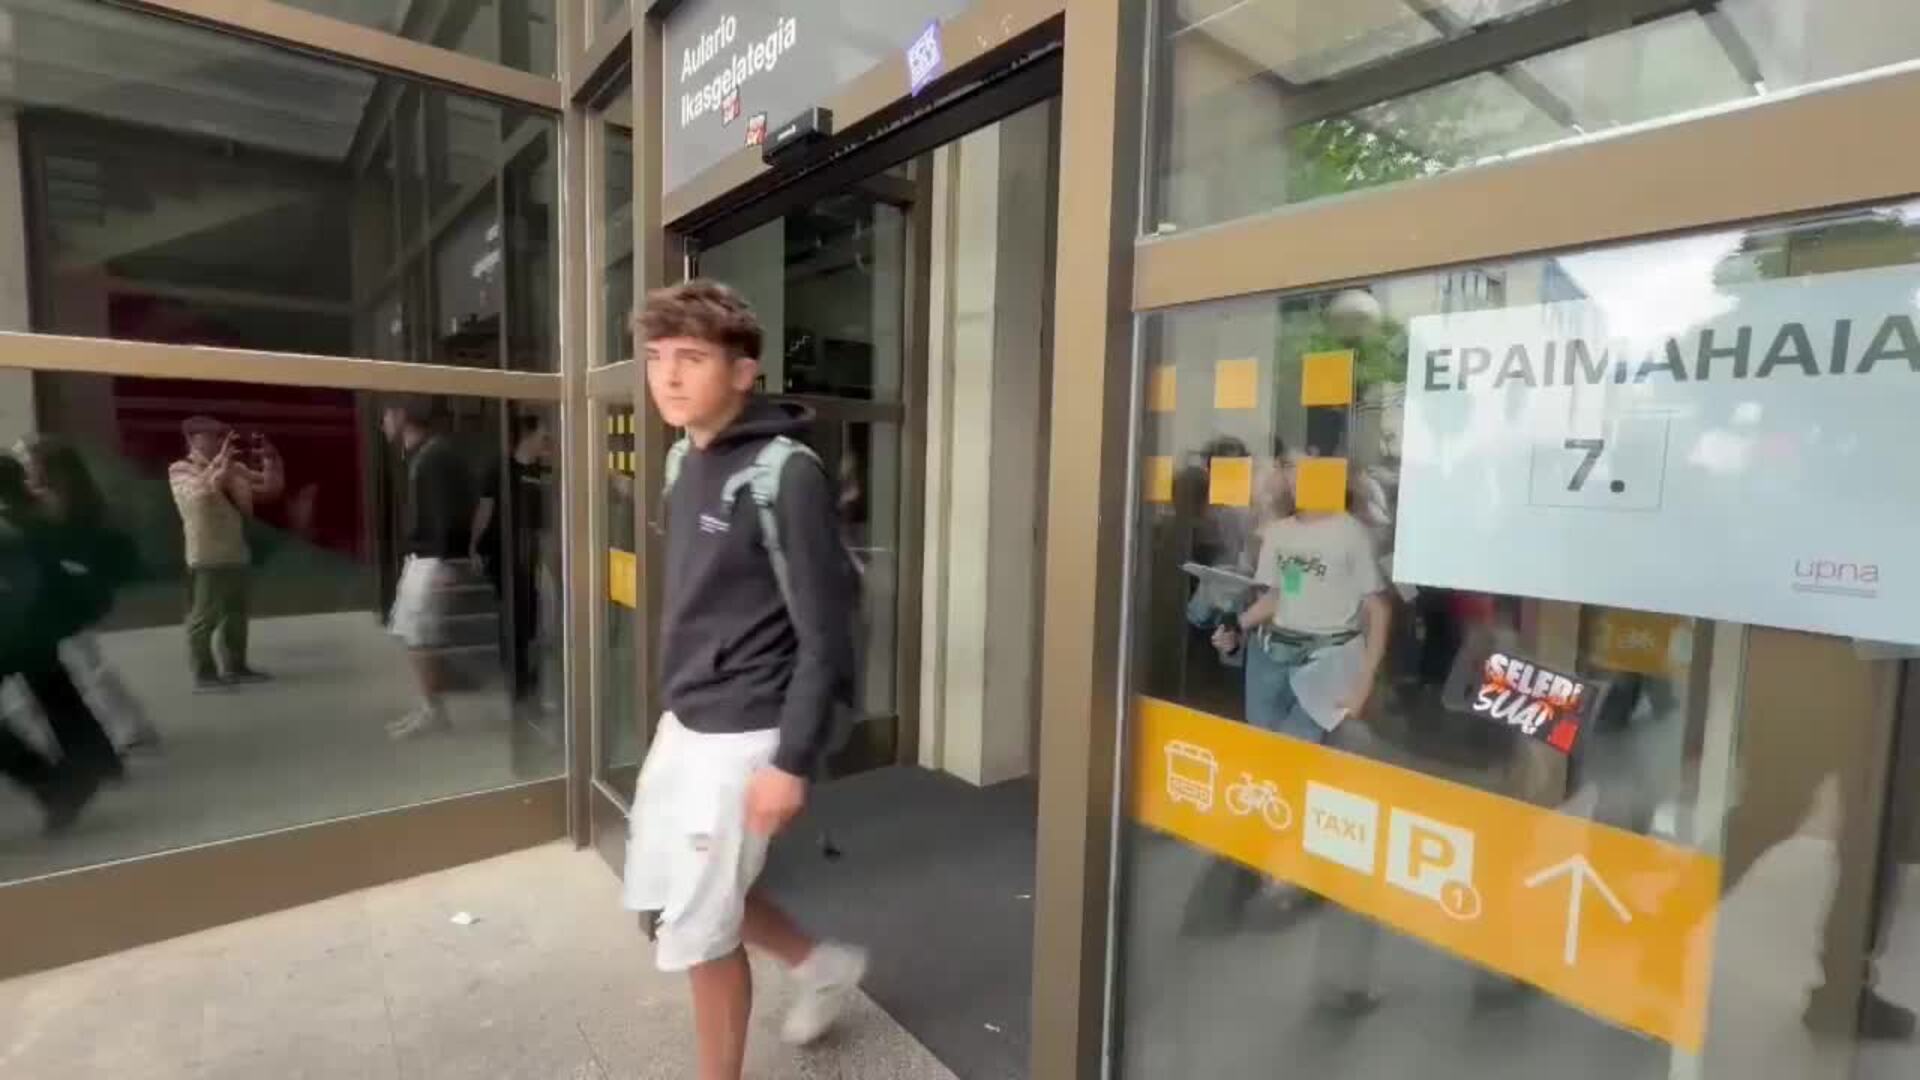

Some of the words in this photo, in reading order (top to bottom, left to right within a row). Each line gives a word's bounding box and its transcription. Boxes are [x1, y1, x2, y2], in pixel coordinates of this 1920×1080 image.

[681, 15, 736, 82] Aulario
[681, 17, 796, 128] Ikasgelategia
[1424, 314, 1920, 392] EPAIMAHAIA
[1564, 438, 1626, 493] 7.
[1794, 558, 1879, 587] upna
[1312, 808, 1367, 844] TAXI
[1409, 824, 1455, 880] P
